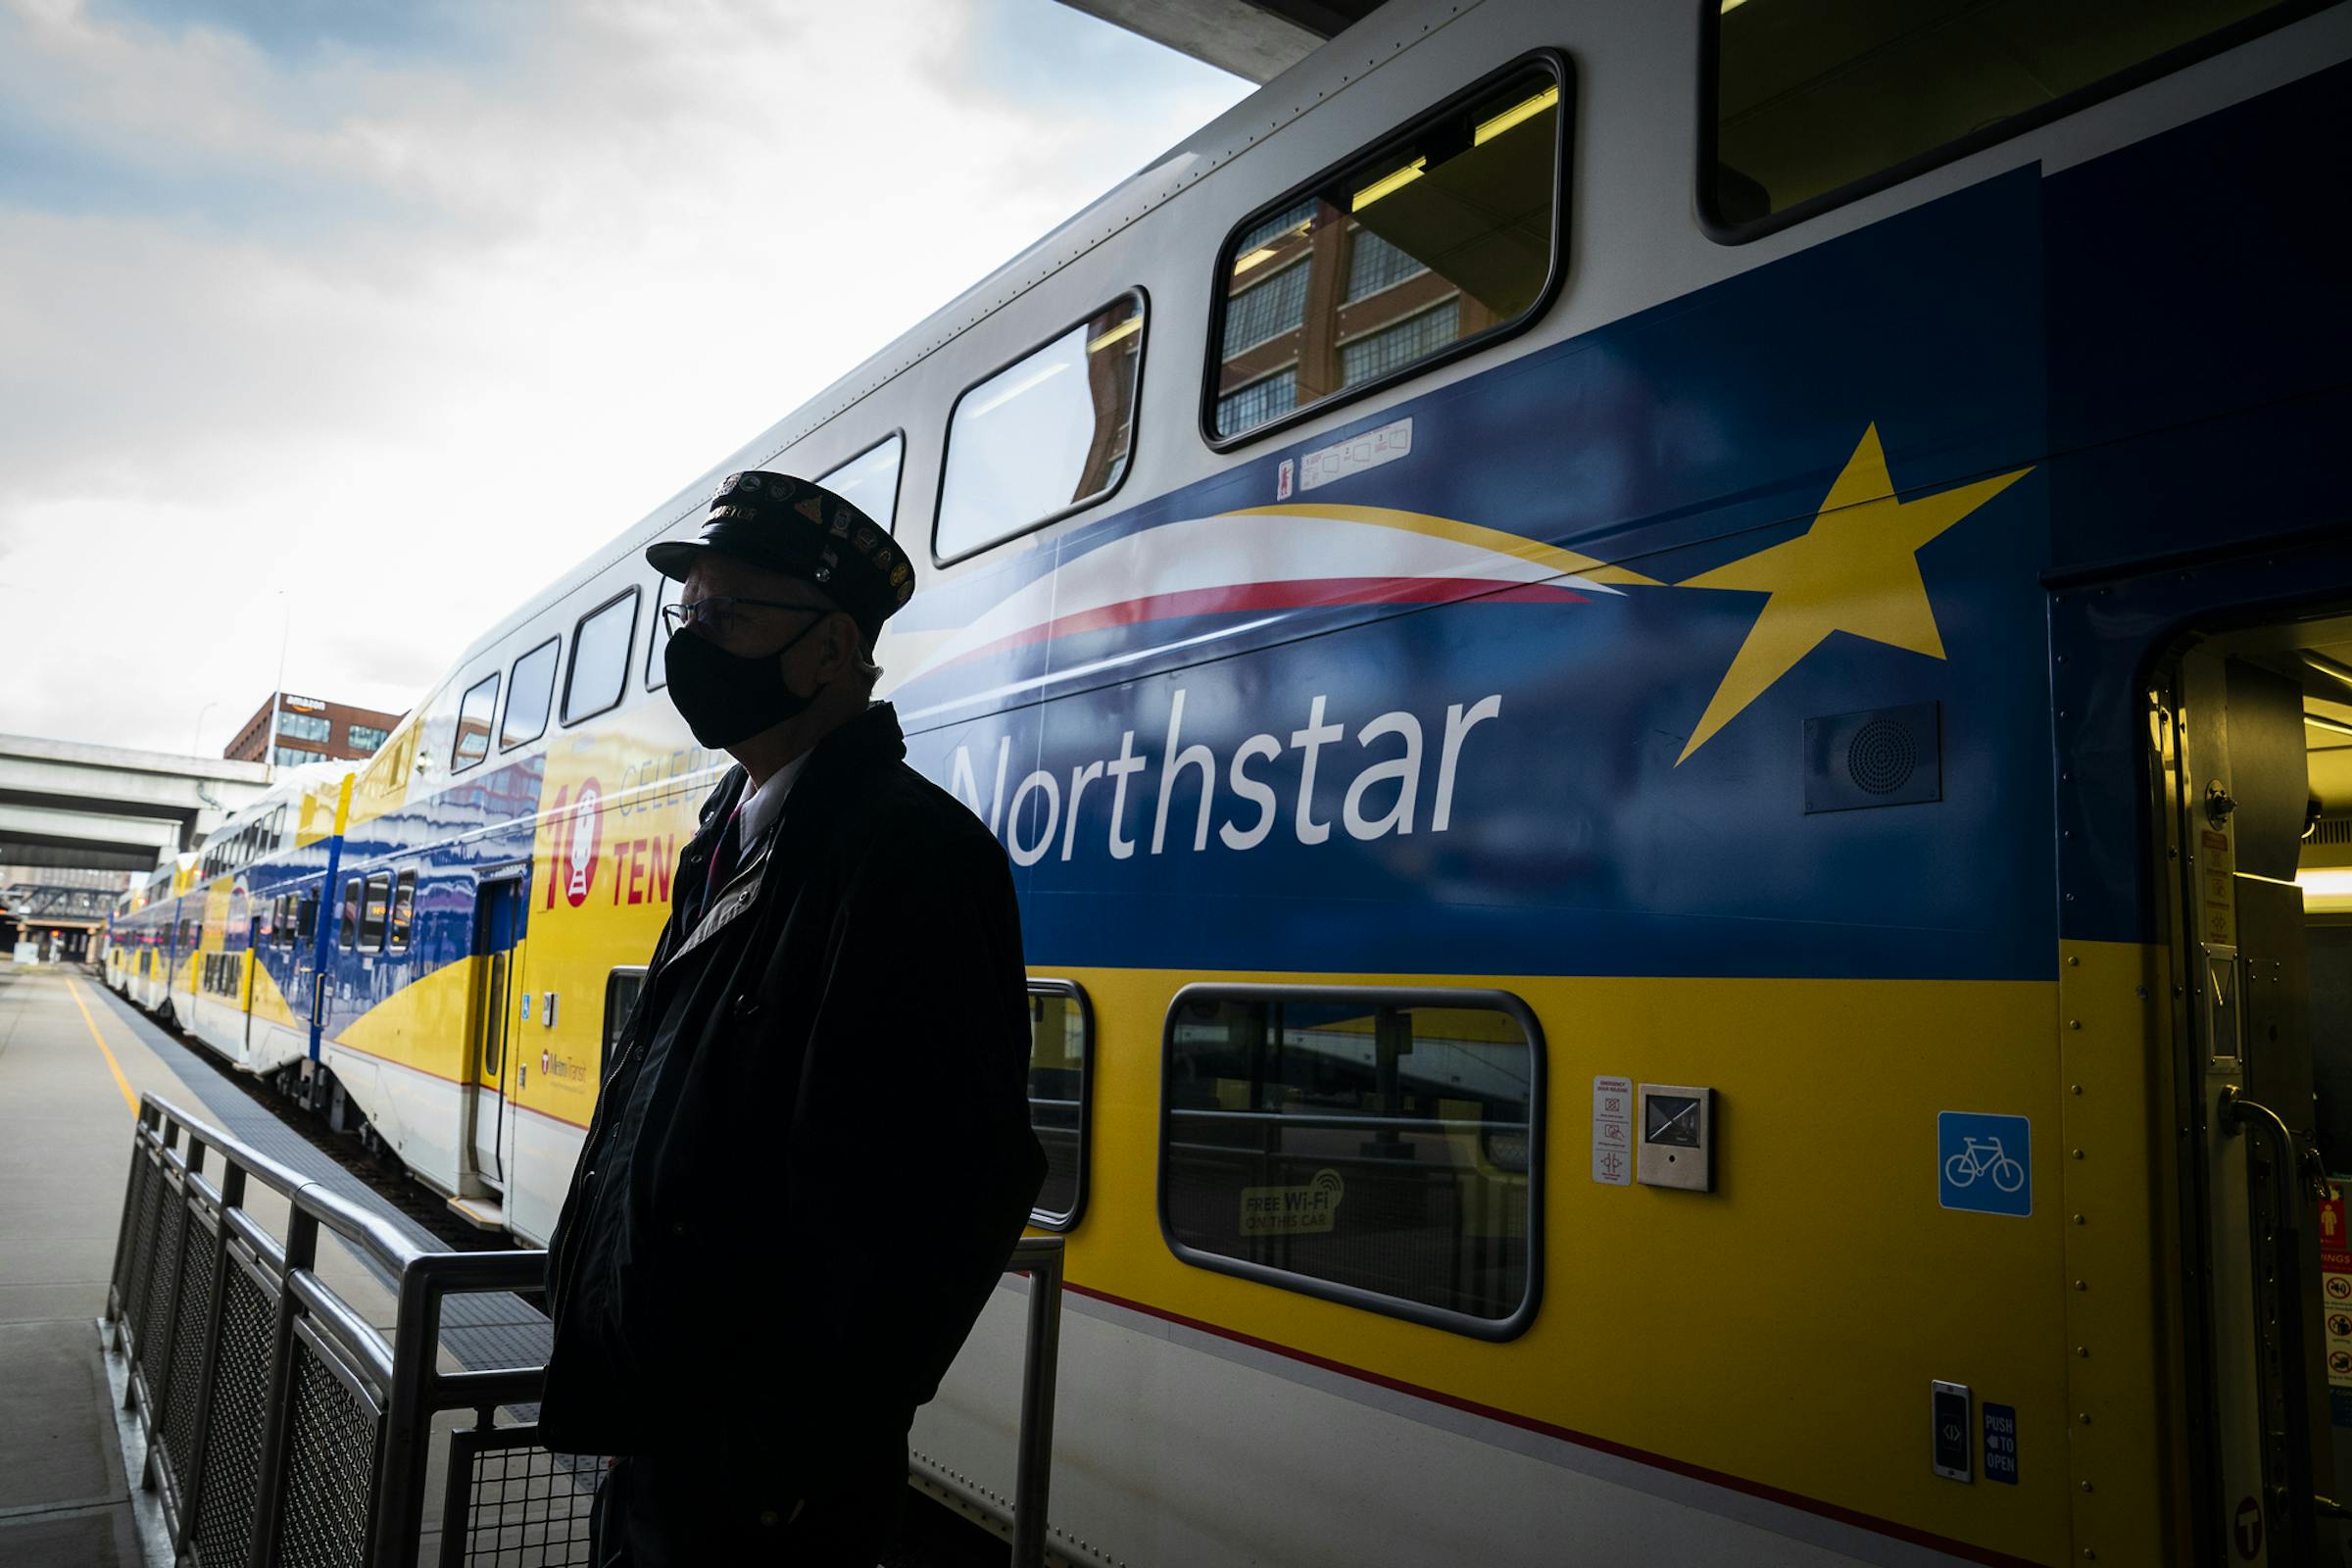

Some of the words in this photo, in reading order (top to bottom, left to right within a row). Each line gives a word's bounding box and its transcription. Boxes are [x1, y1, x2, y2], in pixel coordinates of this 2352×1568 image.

[951, 688, 1502, 866] Northstar
[546, 775, 604, 909] 10
[612, 832, 674, 906] TEN
[1247, 1197, 1280, 1211] FREE
[1285, 1191, 1329, 1211] Wi-Fi
[1246, 1216, 1266, 1230] ON
[1269, 1215, 1298, 1228] THIS
[1301, 1214, 1326, 1227] CAR
[1985, 1413, 2014, 1434] PUSH
[2000, 1436, 2014, 1452] TO
[1986, 1452, 2015, 1472] OPEN
